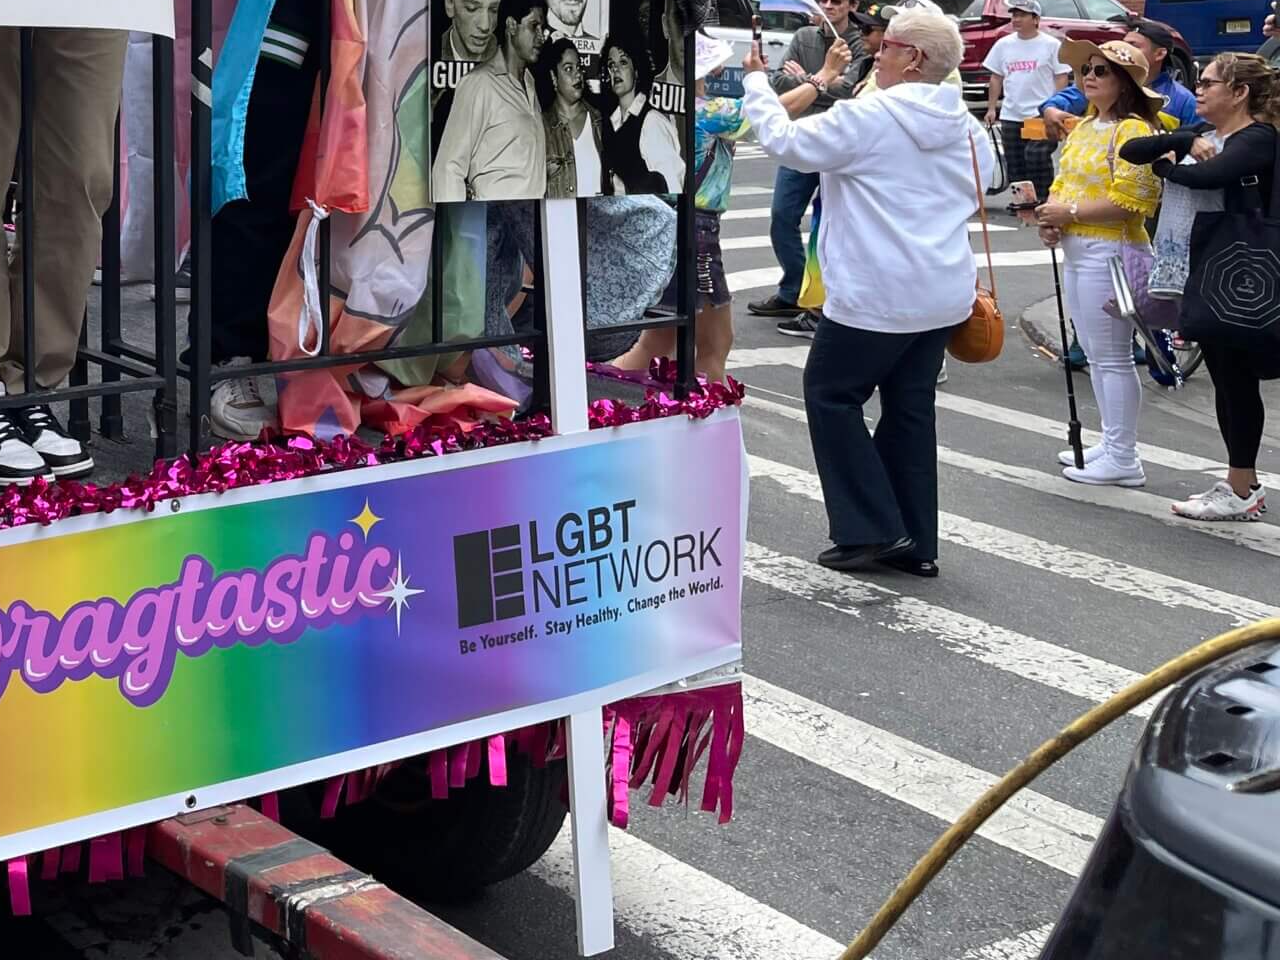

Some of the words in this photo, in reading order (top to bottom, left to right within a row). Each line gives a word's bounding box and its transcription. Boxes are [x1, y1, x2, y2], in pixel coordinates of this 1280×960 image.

[528, 499, 636, 564] LGBT
[532, 526, 723, 613] NETWORK
[459, 639, 477, 655] Be
[480, 625, 538, 650] Yourself.
[545, 619, 572, 636] Stay
[576, 605, 622, 628] Healthy.
[627, 591, 666, 613] Change
[669, 586, 685, 602] the
[688, 576, 724, 596] World.
